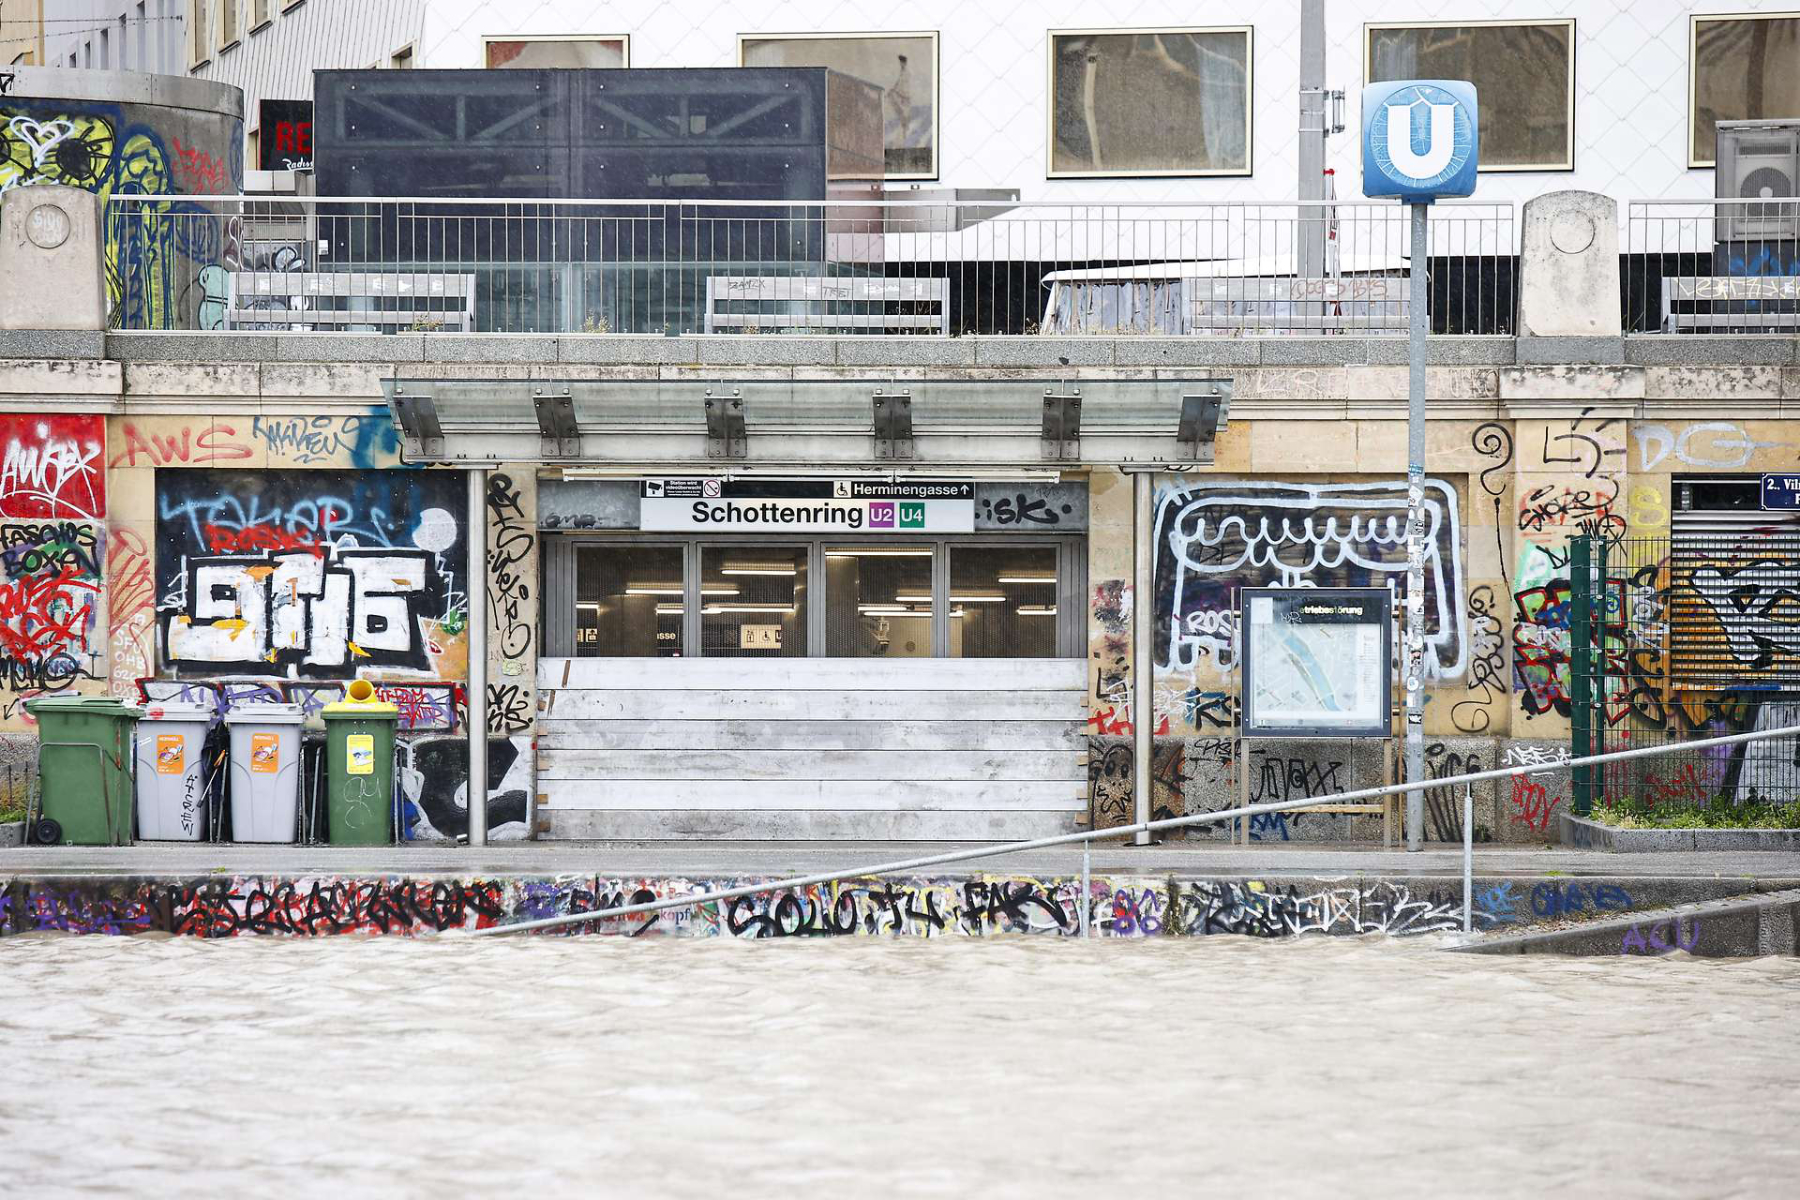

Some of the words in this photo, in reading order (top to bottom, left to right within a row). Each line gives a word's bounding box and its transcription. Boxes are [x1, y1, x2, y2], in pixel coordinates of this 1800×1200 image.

[1388, 105, 1455, 179] U
[854, 483, 958, 496] Herminengasse
[1783, 478, 1800, 490] Vil
[692, 501, 863, 528] Schottenring
[871, 509, 893, 522] U2
[901, 509, 923, 522] U4
